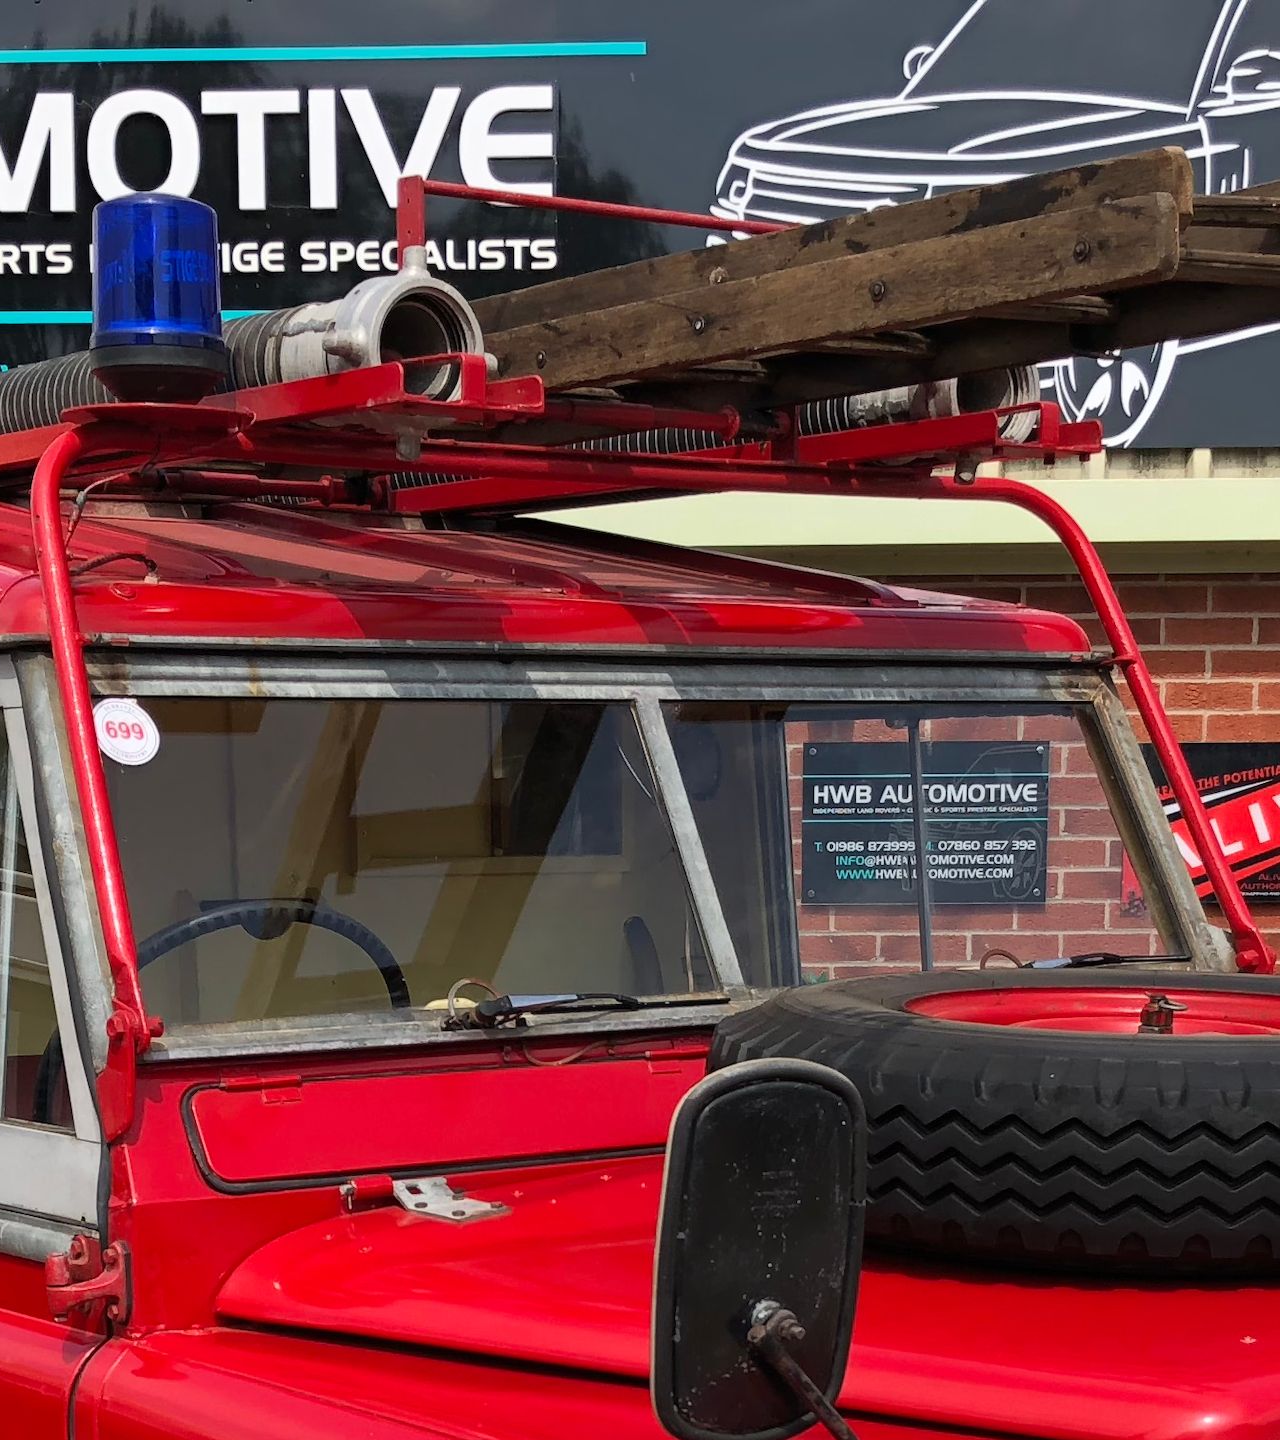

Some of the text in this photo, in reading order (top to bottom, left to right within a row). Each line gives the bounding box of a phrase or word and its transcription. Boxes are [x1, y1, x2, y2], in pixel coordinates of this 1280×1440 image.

[300, 239, 558, 273] SPECALISTS
[105, 720, 145, 741] 699
[1196, 776, 1220, 791] THE
[813, 784, 872, 804] HWB
[826, 841, 865, 852] 01986
[867, 841, 916, 852] 873999
[937, 840, 981, 851] 07860
[983, 840, 1009, 851] 857
[1011, 839, 1037, 851] 392
